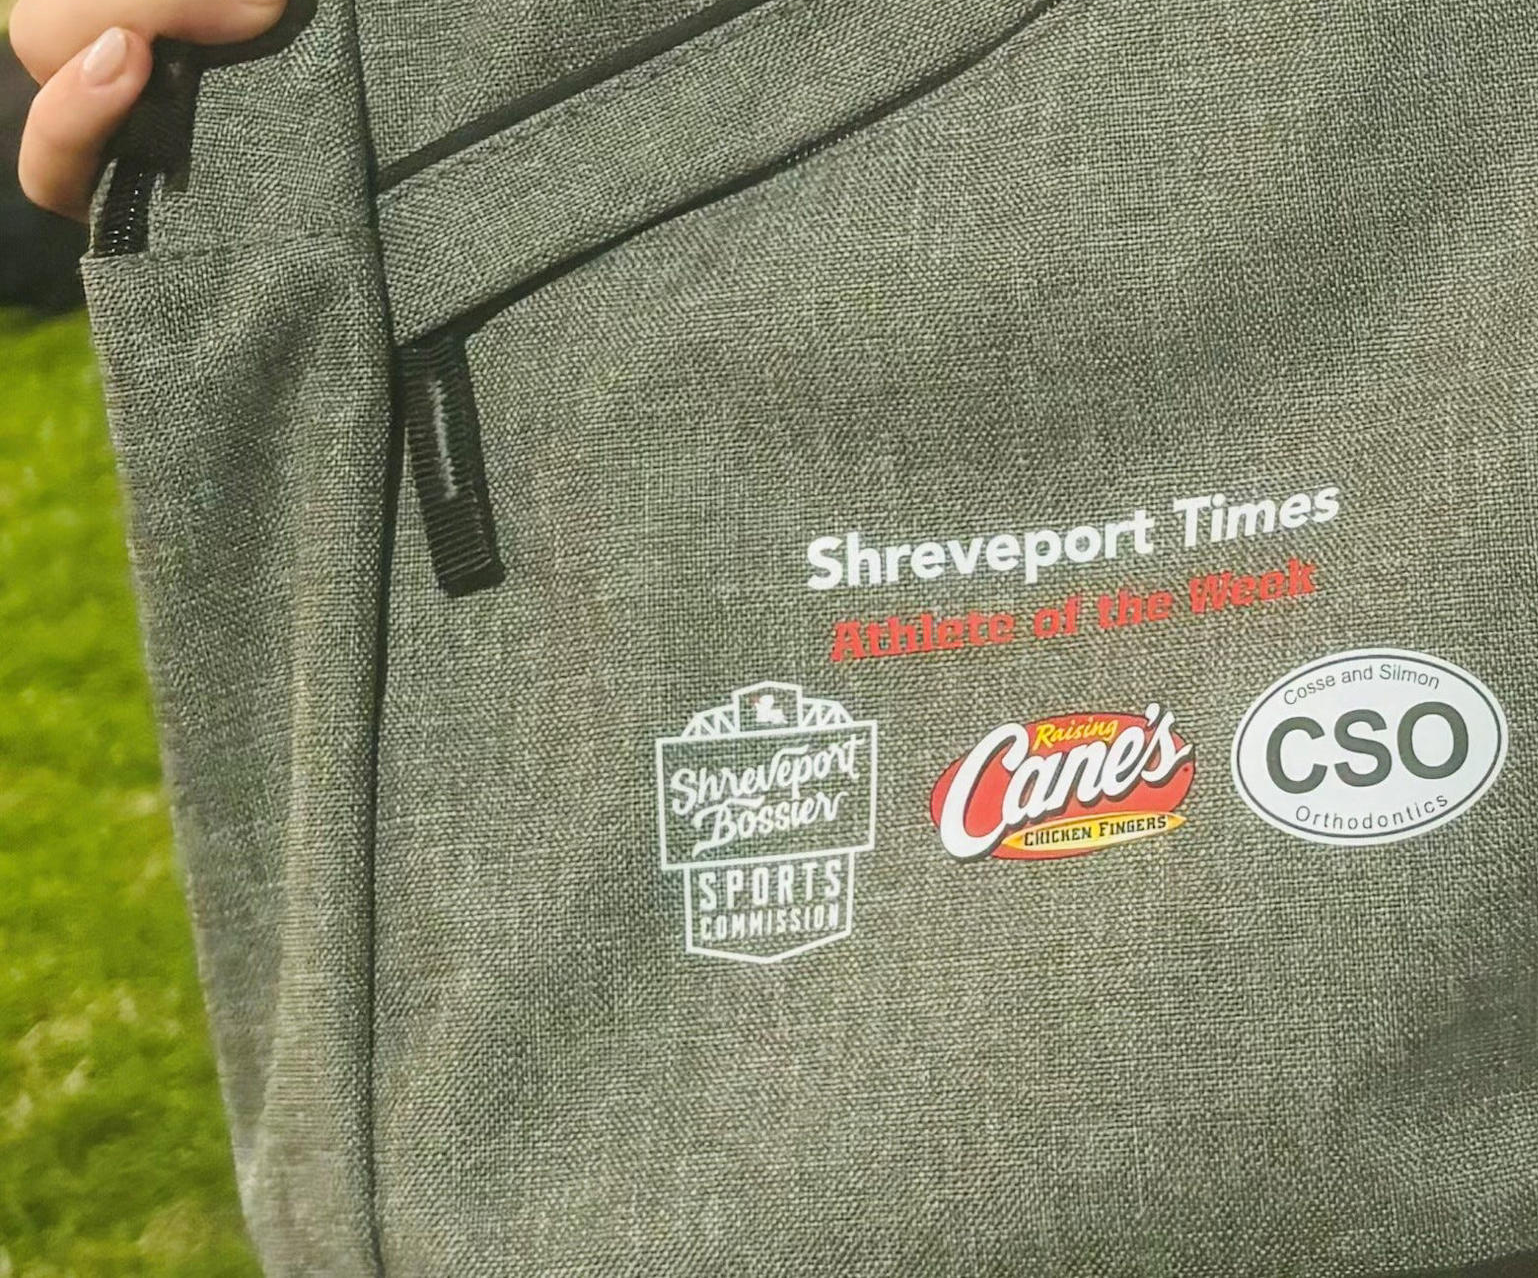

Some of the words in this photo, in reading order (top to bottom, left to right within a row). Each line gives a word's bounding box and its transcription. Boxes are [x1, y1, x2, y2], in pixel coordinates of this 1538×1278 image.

[806, 509, 1155, 591] Shreveport
[1174, 485, 1341, 547] Times
[830, 612, 1016, 663] Athlete
[1034, 594, 1084, 640] of
[1097, 589, 1173, 631] the
[1188, 556, 1319, 614] Week
[1283, 673, 1337, 706] Cosse
[1341, 666, 1374, 684] and
[1379, 663, 1440, 690] Silmon
[1032, 717, 1120, 751] Raising
[1265, 700, 1470, 795] CSO
[669, 733, 865, 816] Shreveport
[939, 702, 1194, 859] Cane's
[690, 790, 849, 859] Bossier
[1023, 826, 1092, 847] CHICKEN
[1098, 814, 1167, 837] FINGERS
[1295, 794, 1449, 831] Orthodontics
[699, 858, 842, 912] SPORTS
[699, 902, 840, 941] COMMISSION
